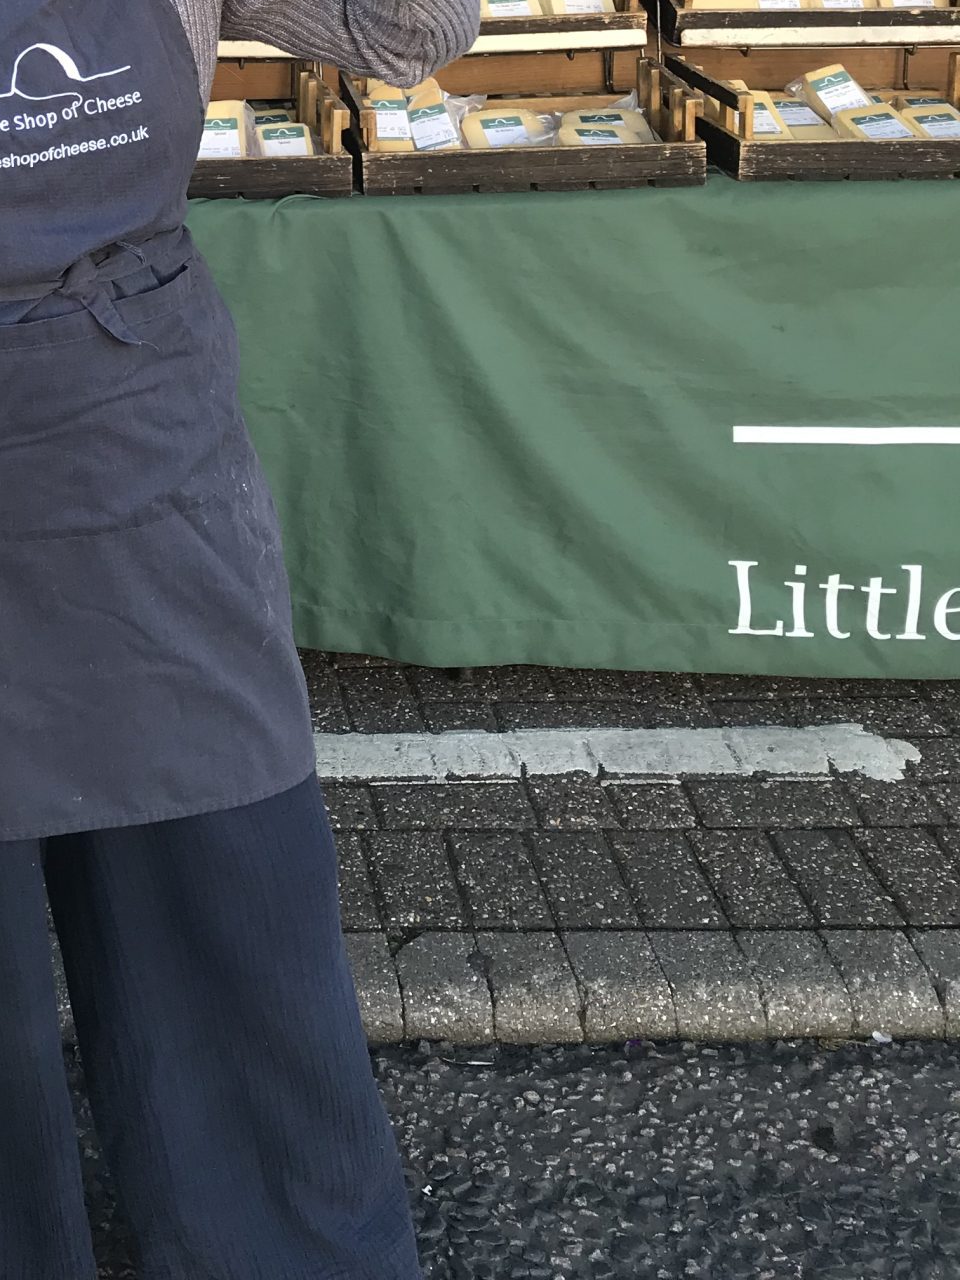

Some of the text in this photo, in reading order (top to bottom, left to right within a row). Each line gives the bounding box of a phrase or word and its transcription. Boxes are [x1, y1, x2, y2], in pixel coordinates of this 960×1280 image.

[14, 112, 57, 130] Shop
[61, 98, 82, 120] of
[84, 91, 142, 115] Cheese
[728, 561, 960, 641] Little
